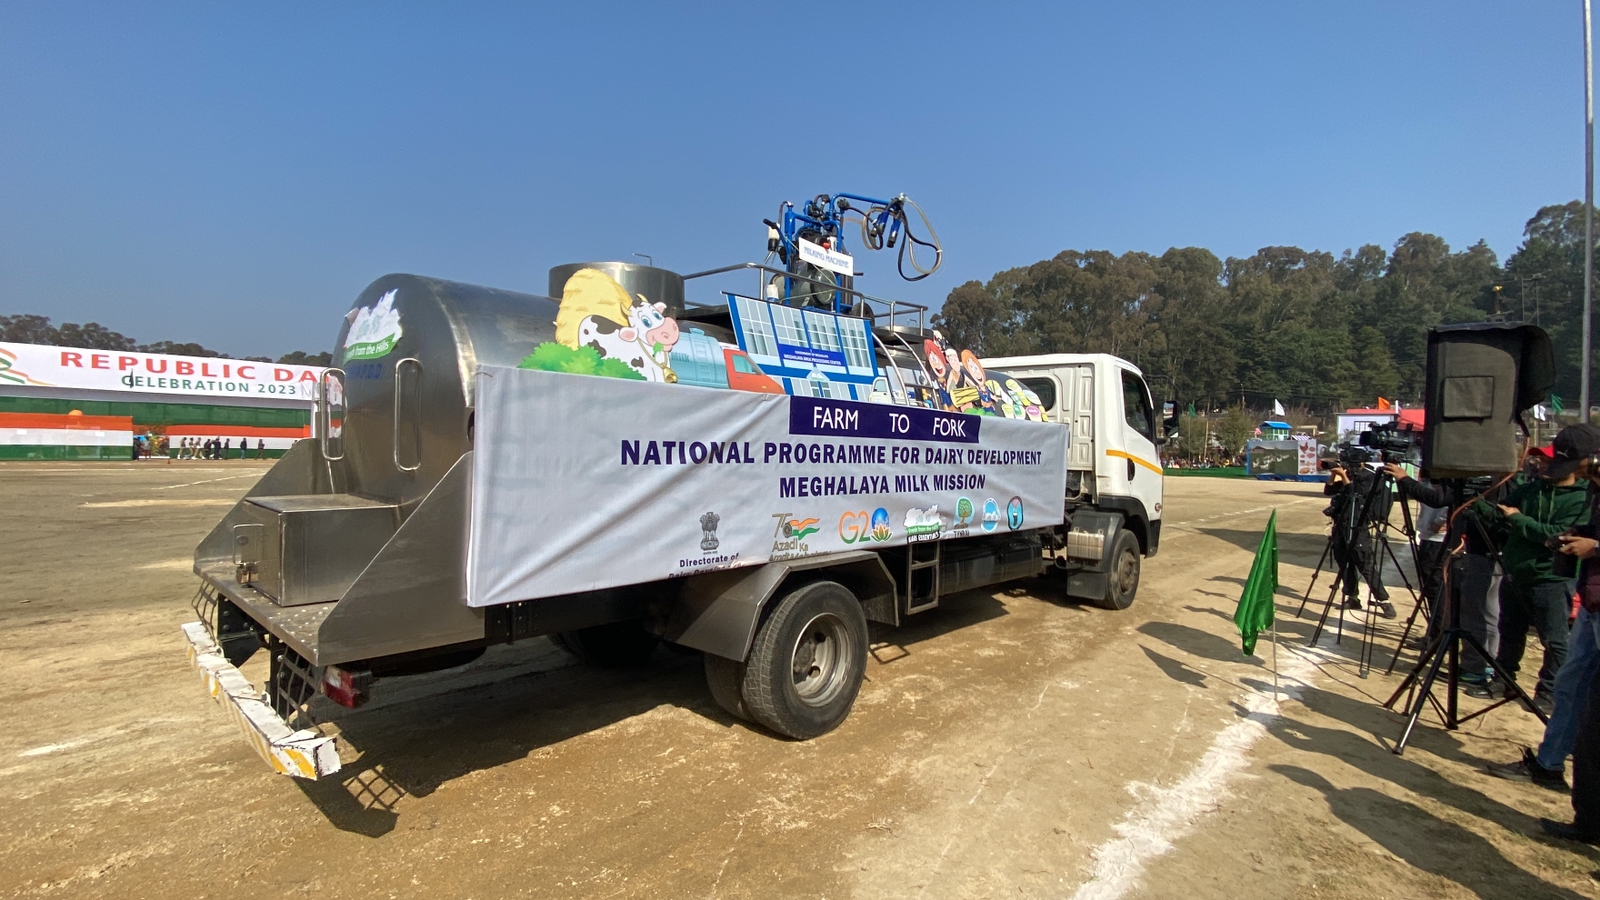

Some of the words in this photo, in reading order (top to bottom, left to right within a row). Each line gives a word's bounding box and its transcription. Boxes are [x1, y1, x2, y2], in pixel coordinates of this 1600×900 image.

[804, 246, 825, 261] MILKING
[825, 255, 849, 269] MACHINE
[366, 344, 376, 355] the
[376, 339, 389, 354] Hills
[60, 351, 256, 380] REPUBLIC
[121, 375, 249, 393] CELEBRATION
[257, 383, 296, 395] 2023
[813, 405, 859, 430] FARM
[889, 413, 910, 433] TO
[932, 417, 967, 437] FORK
[621, 439, 755, 465] NATIONAL
[764, 442, 886, 464] PROGRAMME
[891, 446, 920, 464] FOR
[925, 448, 964, 465] DAIRY
[967, 449, 1042, 465] DEVELOPMENT
[779, 475, 890, 498] MEGHALAYA
[894, 474, 930, 493] MILK
[933, 474, 986, 491] MISSION
[771, 537, 798, 552] Azadi
[679, 555, 729, 567] Directorate
[730, 552, 740, 561] of
